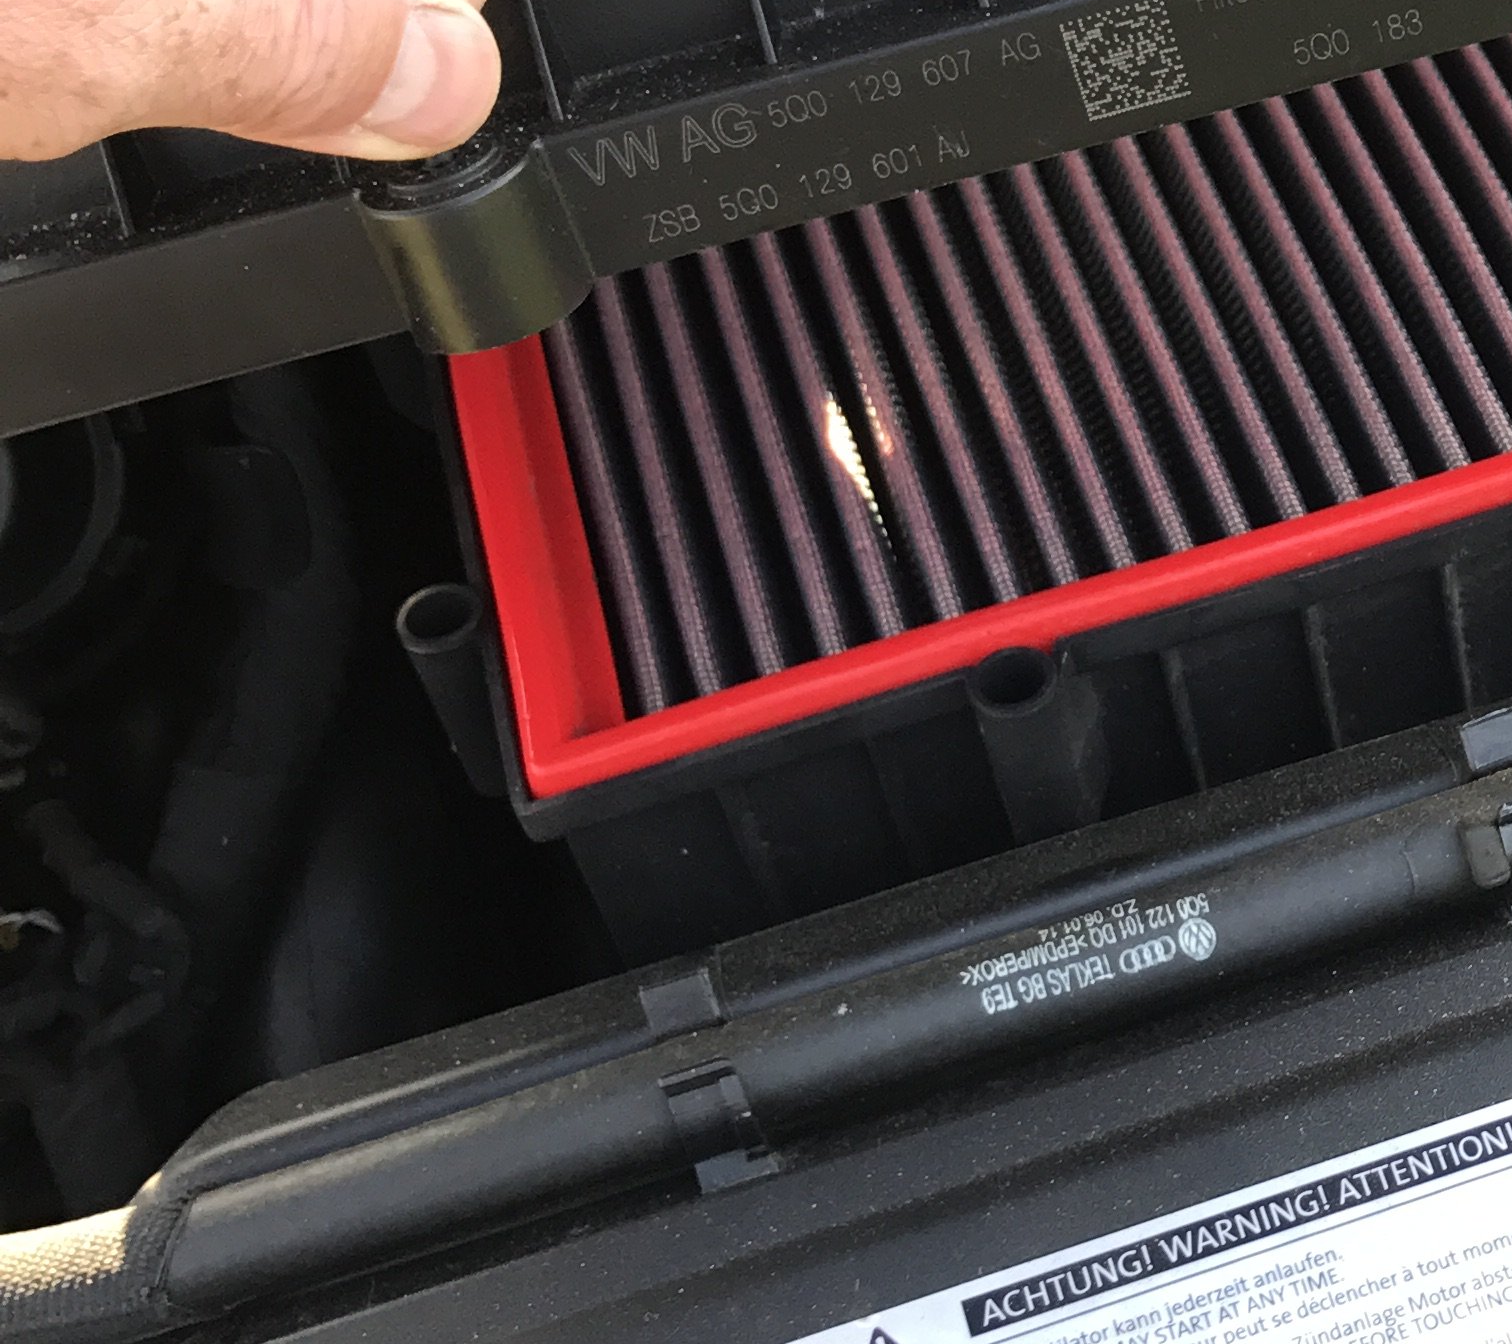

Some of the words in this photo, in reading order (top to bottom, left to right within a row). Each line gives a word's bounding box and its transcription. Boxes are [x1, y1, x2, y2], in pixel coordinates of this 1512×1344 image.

[1371, 7, 1424, 46] 183
[567, 124, 663, 192] VW
[674, 98, 757, 163] AG
[847, 66, 903, 109] 129
[920, 47, 975, 88] 607
[997, 29, 1041, 67] AG
[642, 203, 702, 243] ZSB
[797, 162, 853, 199] 129
[869, 143, 923, 179] 601
[1117, 913, 1145, 939] 101
[1144, 902, 1176, 929] 122
[1015, 972, 1048, 1003] BG
[1044, 953, 1116, 995] TEKLAS
[983, 1244, 1153, 1326] ACHTUNG!
[1158, 1184, 1329, 1262] WARNING!
[1112, 1309, 1161, 1336] kann
[1164, 1277, 1250, 1323] jederzeit
[1252, 1249, 1343, 1288] anlaufen.
[1153, 1310, 1211, 1344] START
[1218, 1300, 1239, 1323] AT
[1247, 1285, 1284, 1313] ANY
[1287, 1267, 1344, 1296] TIME.
[1271, 1310, 1293, 1328] se
[1296, 1272, 1397, 1318] déclencher
[1401, 1265, 1413, 1282] à
[1416, 1250, 1459, 1276] tout
[1407, 1281, 1466, 1312] Motor
